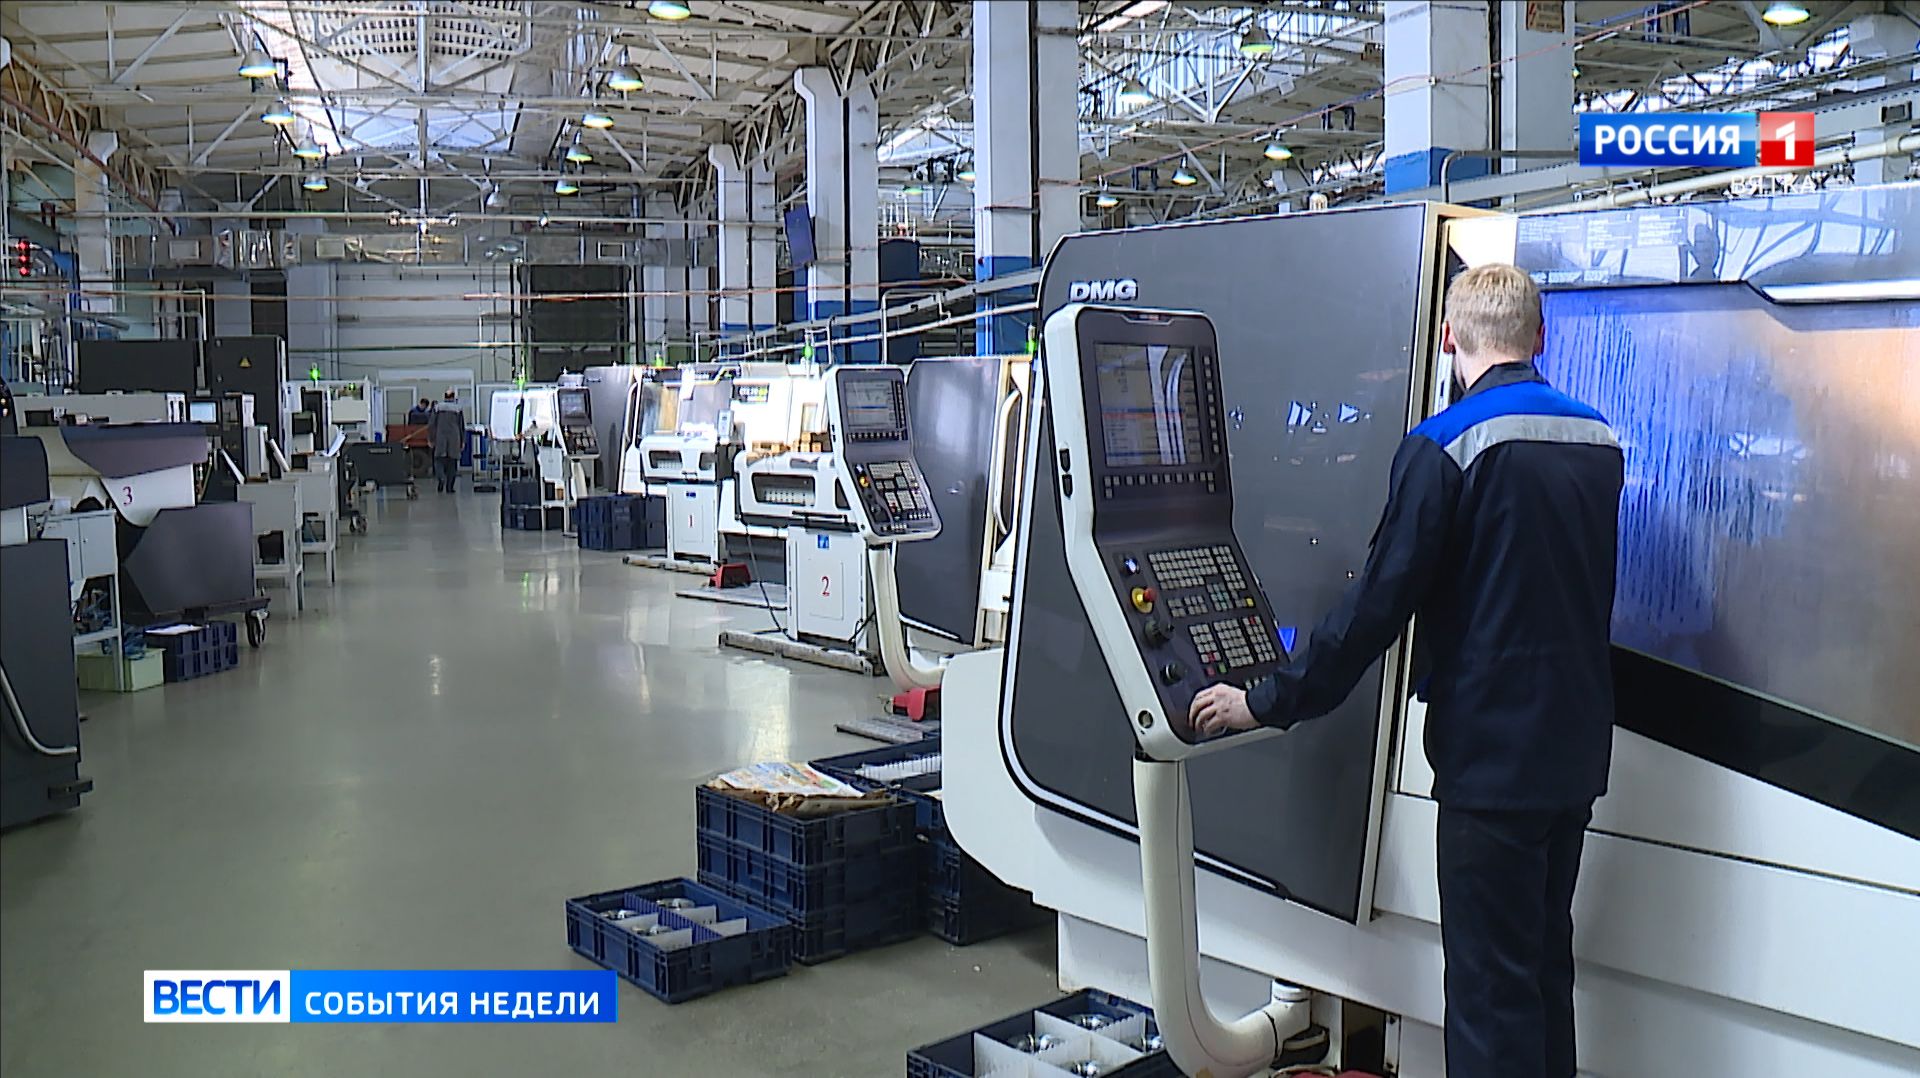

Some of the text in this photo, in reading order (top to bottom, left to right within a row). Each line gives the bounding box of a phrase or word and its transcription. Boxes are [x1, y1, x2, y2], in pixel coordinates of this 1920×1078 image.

[1070, 279, 1137, 301] DMG
[122, 485, 133, 506] 3
[821, 575, 831, 597] 2
